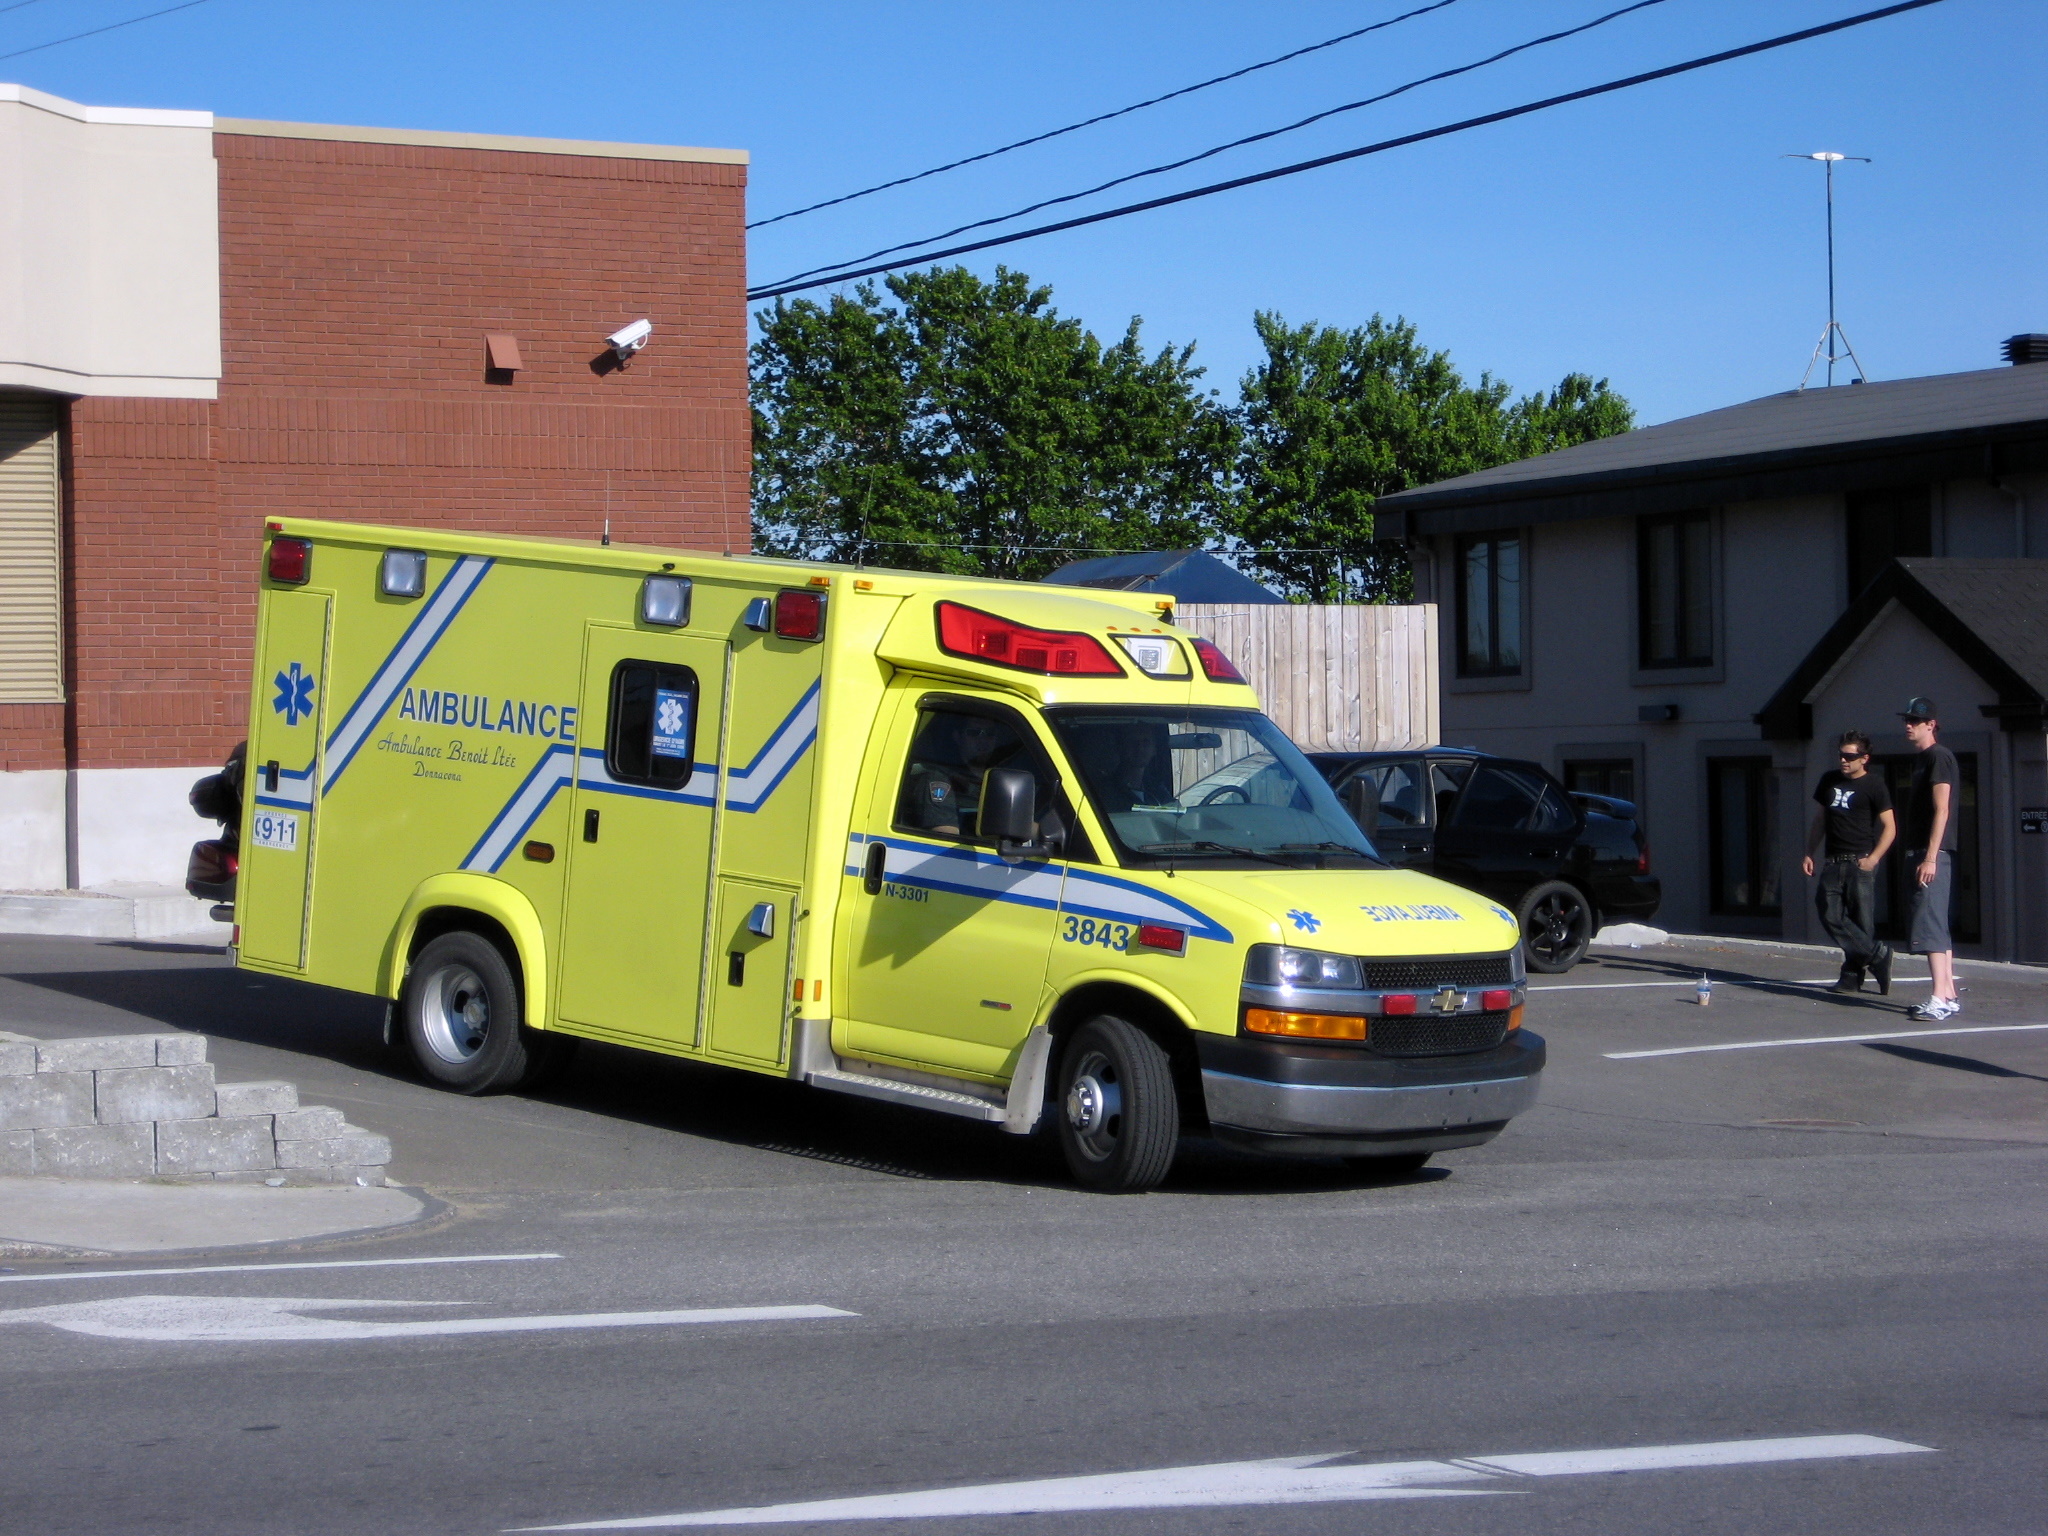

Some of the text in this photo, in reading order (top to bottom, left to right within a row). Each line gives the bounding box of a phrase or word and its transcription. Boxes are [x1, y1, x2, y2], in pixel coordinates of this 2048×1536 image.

[398, 686, 578, 742] AMBULANCE
[377, 732, 442, 758] Ambulance
[413, 761, 462, 782] Donnacona
[885, 883, 930, 903] N-3301
[1062, 915, 1130, 952] 3843
